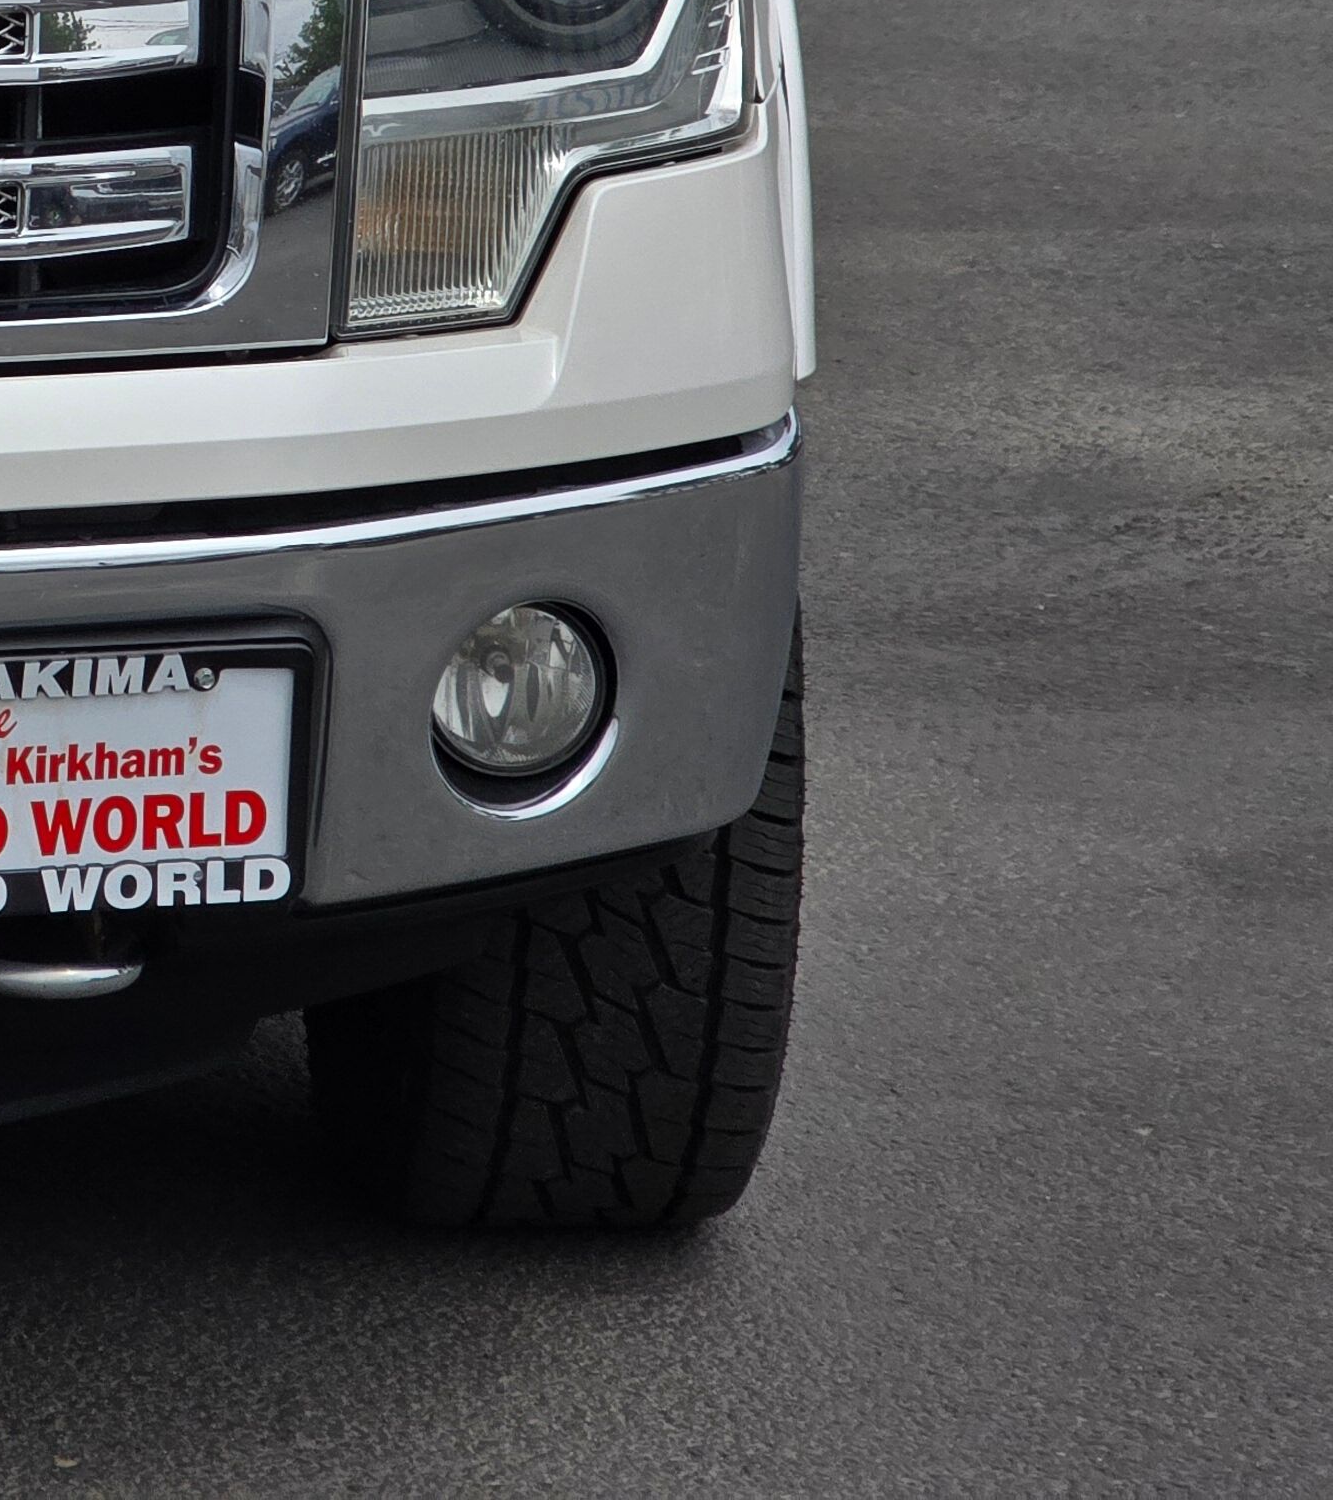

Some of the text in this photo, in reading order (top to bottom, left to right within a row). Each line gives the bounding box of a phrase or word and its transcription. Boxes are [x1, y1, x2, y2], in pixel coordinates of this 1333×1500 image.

[5, 736, 224, 786] Kirkham's
[32, 789, 268, 857] WORLD
[41, 856, 292, 915] WORLD
